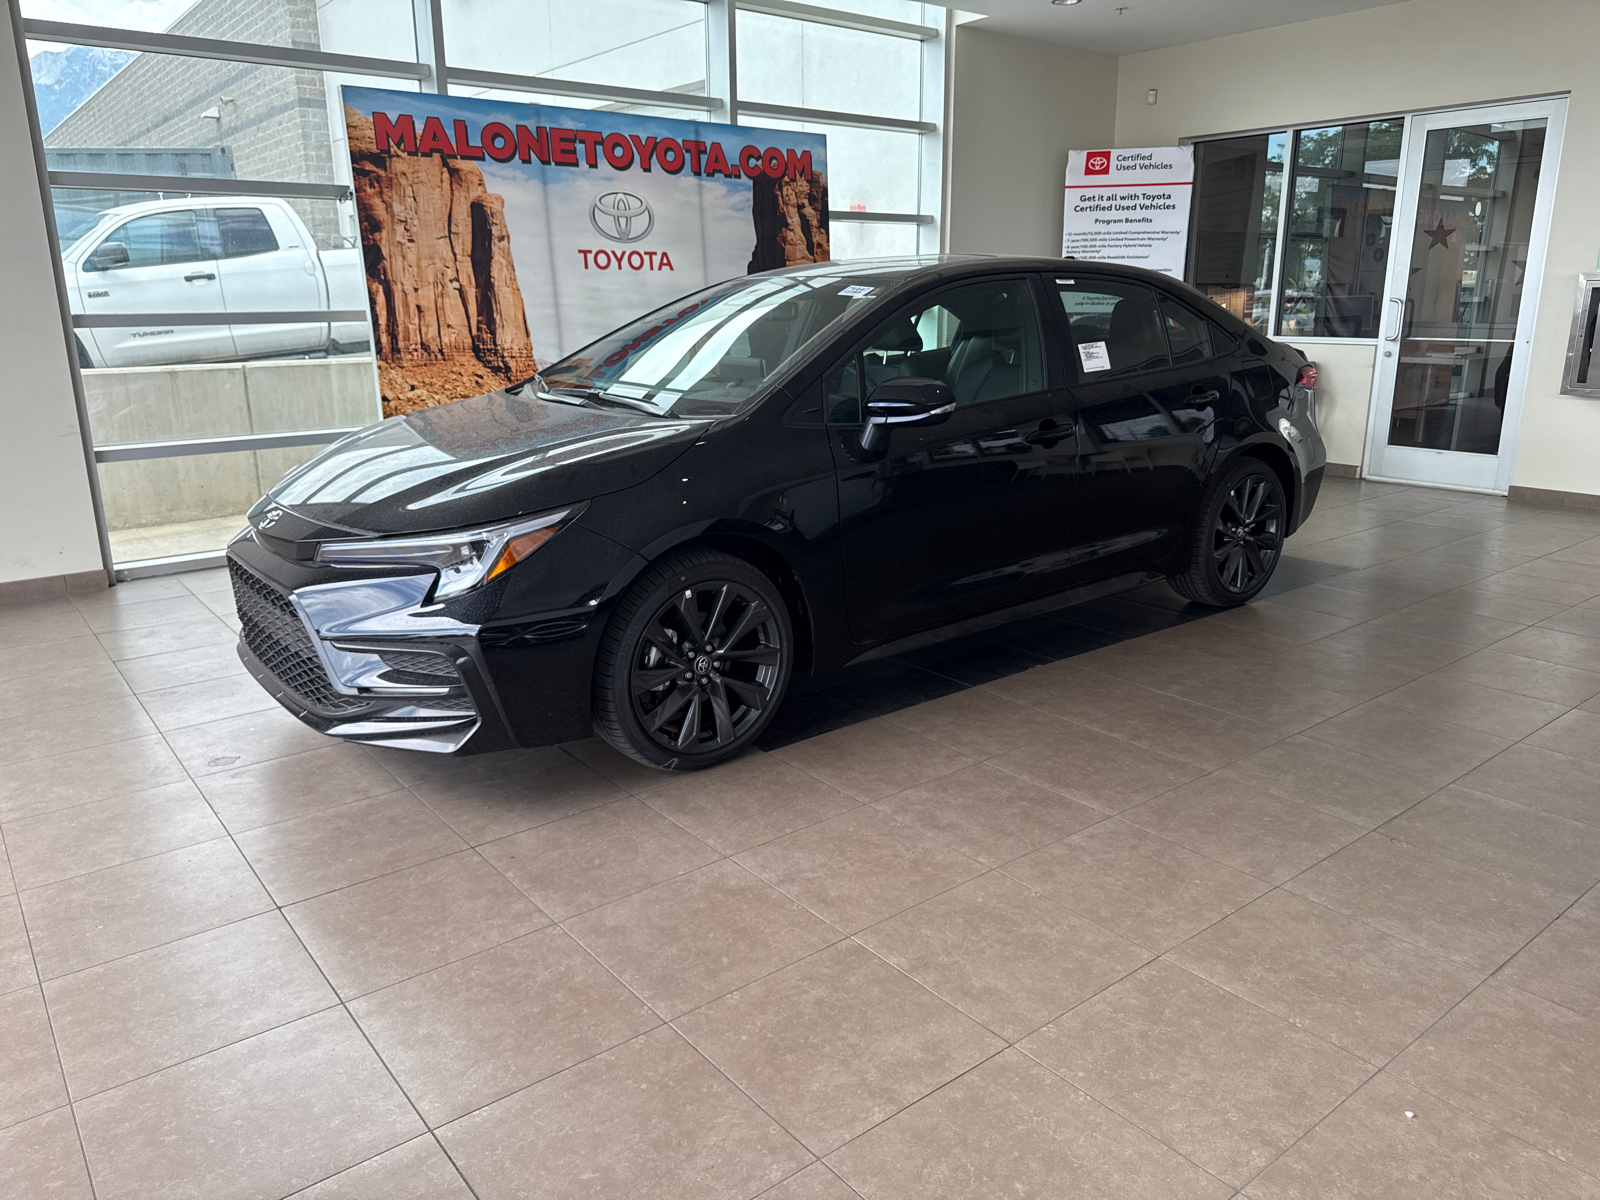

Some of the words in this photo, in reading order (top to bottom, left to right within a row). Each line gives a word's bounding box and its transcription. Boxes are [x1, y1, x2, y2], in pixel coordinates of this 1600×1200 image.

[372, 111, 813, 182] MALONETOYOTA.COM
[1116, 153, 1153, 162] Certified
[1115, 163, 1137, 171] Used
[1139, 162, 1173, 170] Vehicles
[1097, 194, 1104, 202] it
[1105, 194, 1118, 202] all
[1119, 193, 1140, 201] with
[1141, 193, 1172, 202] Toyota
[1073, 204, 1113, 213] Certified
[1114, 203, 1137, 211] Used
[1138, 202, 1176, 211] Vehicles
[1094, 218, 1124, 226] Program
[577, 248, 675, 271] TOYOTA
